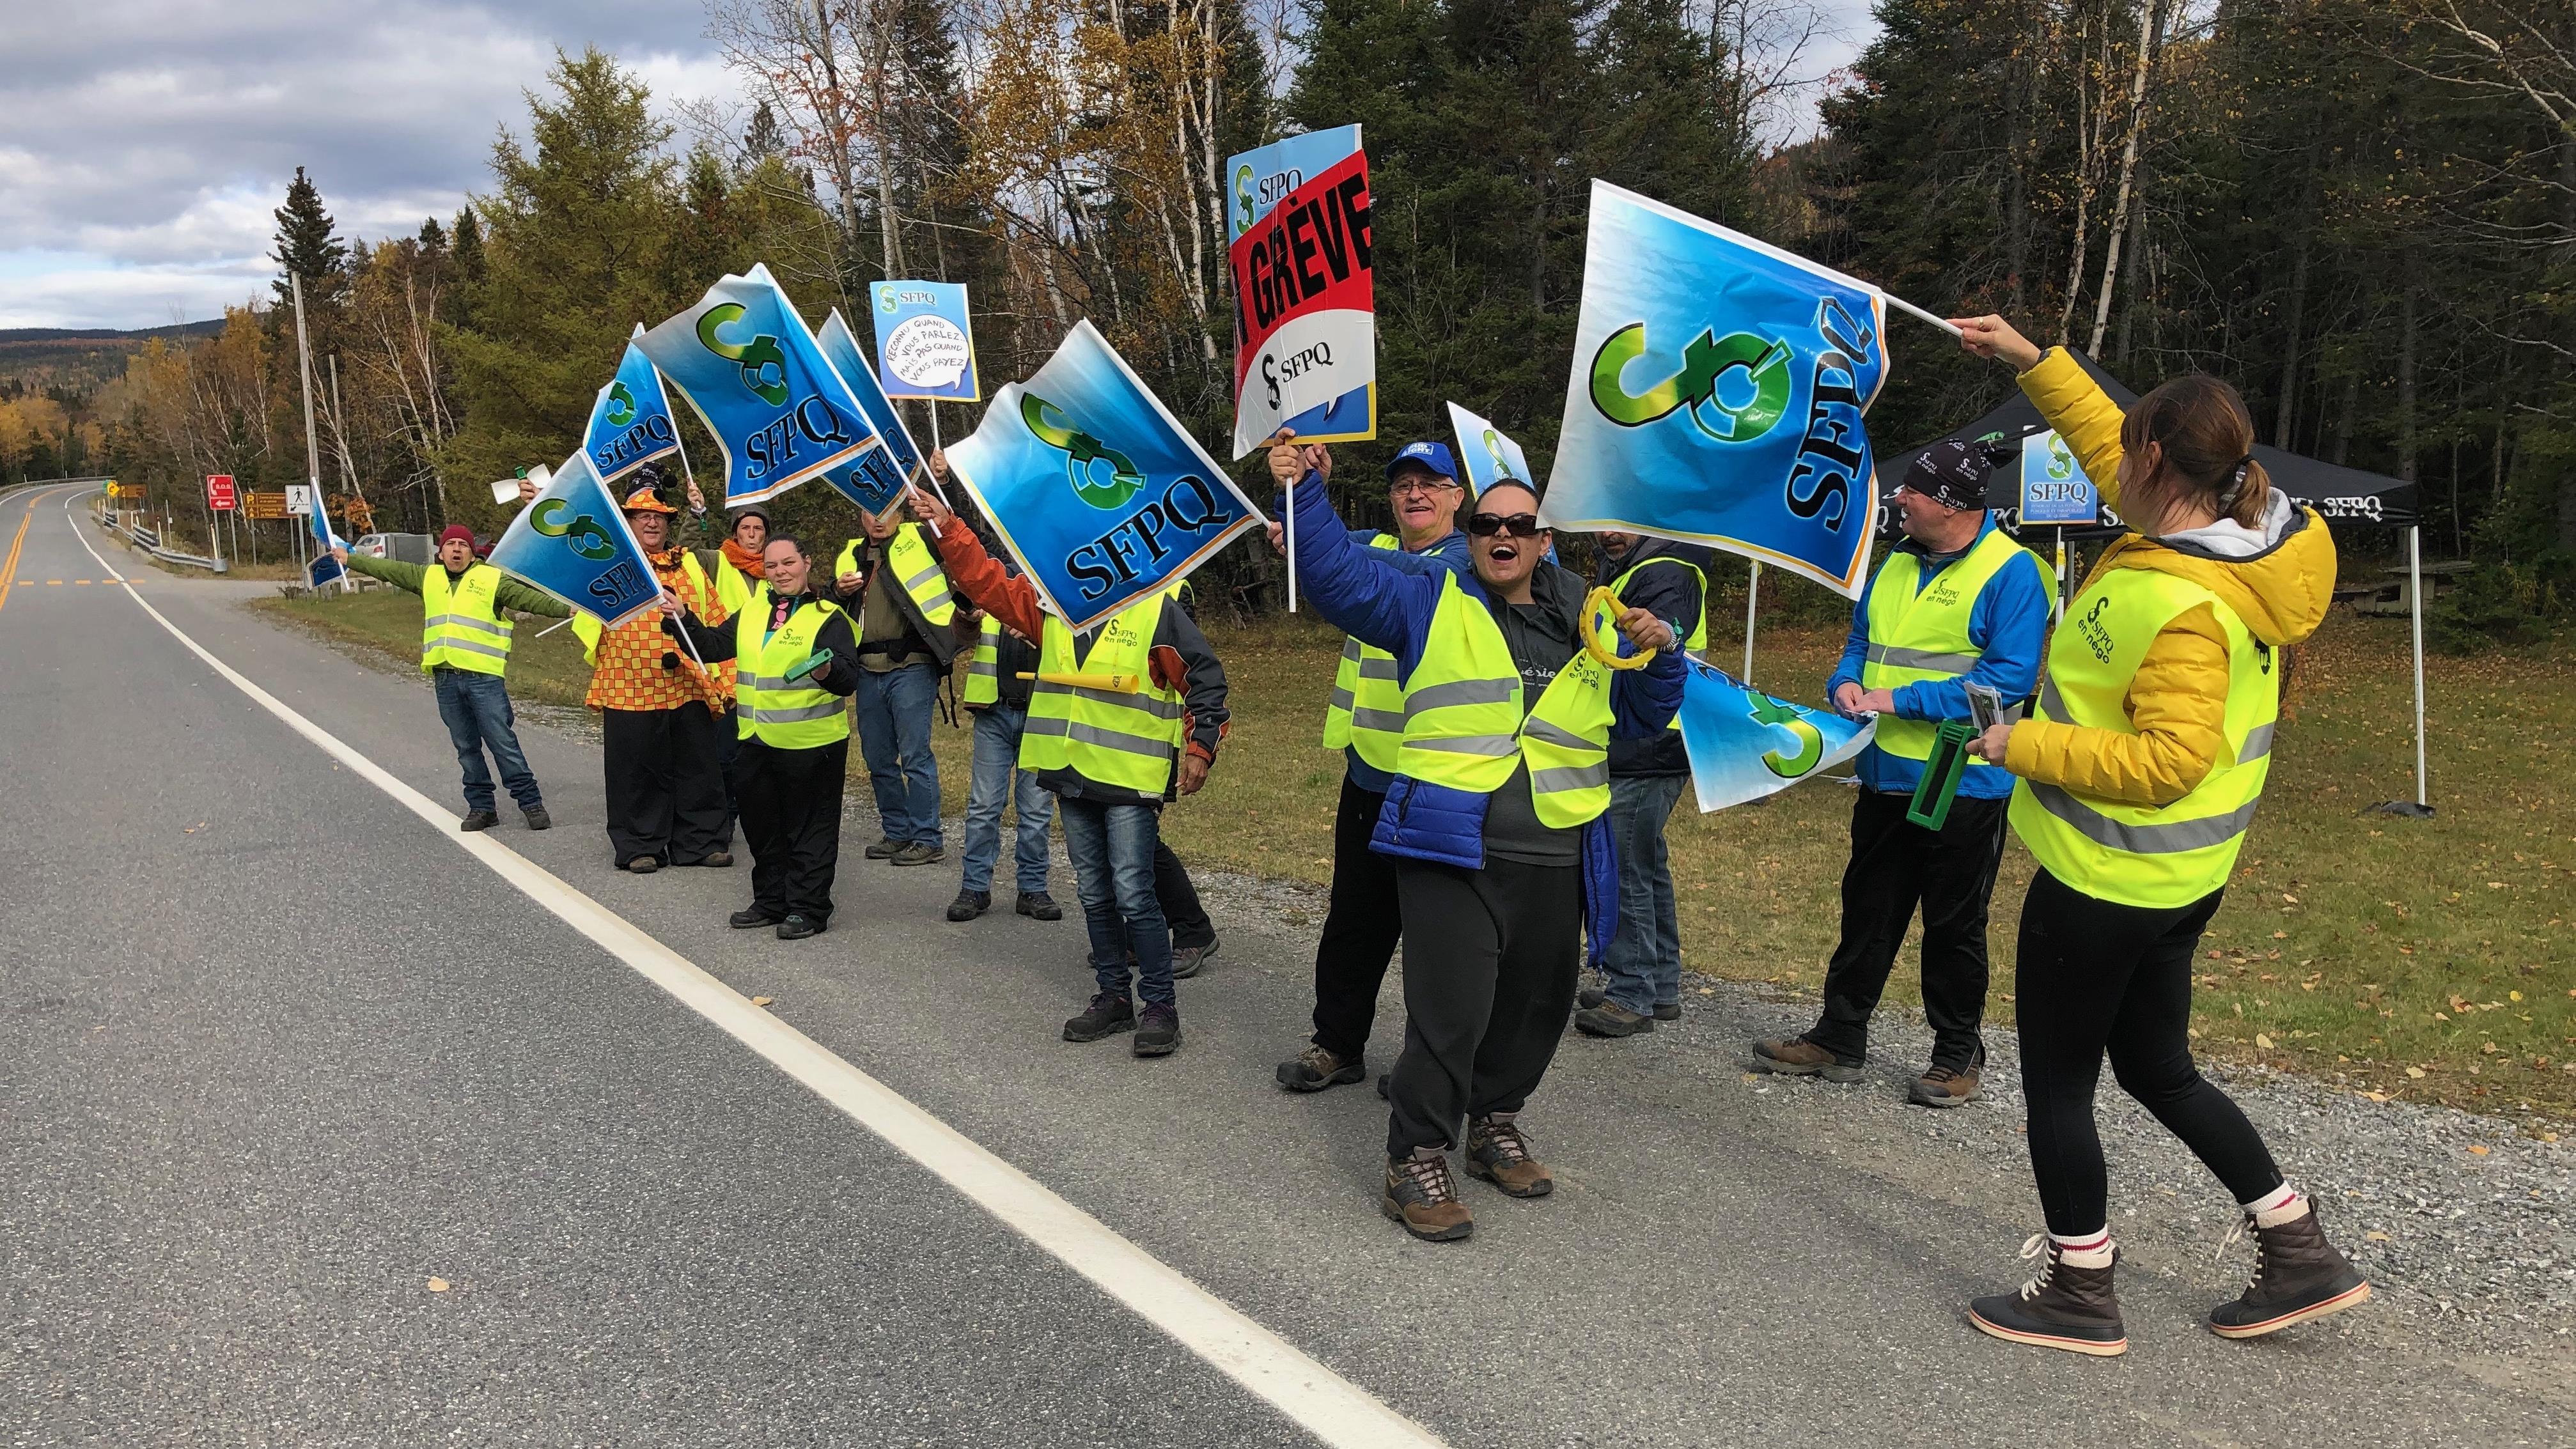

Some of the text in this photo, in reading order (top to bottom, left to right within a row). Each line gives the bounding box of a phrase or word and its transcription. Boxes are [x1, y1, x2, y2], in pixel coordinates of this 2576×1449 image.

[1250, 172, 1373, 330] GRÈVE
[900, 292, 935, 306] SFPQ
[887, 319, 944, 361] RECONNU QUAND
[902, 336, 919, 356] VOUS
[915, 343, 932, 358] PAS
[933, 343, 962, 352] QUAND
[910, 358, 964, 381] VOUS PAYEZ
[1281, 341, 1334, 383] SFPQ
[1786, 297, 1873, 532] SFPQ
[597, 414, 676, 469] SFPQ
[746, 395, 850, 479] SFPQ
[2030, 482, 2087, 504] SFPQ
[2323, 495, 2383, 522] SFPQ
[1066, 476, 1231, 601] SFPQ
[1936, 596, 1956, 607] négo
[1939, 587, 1960, 599] SFPQ
[1117, 630, 1137, 640] SFPQ
[2078, 619, 2109, 664] en négo
[2092, 621, 2114, 655] SFPQ
